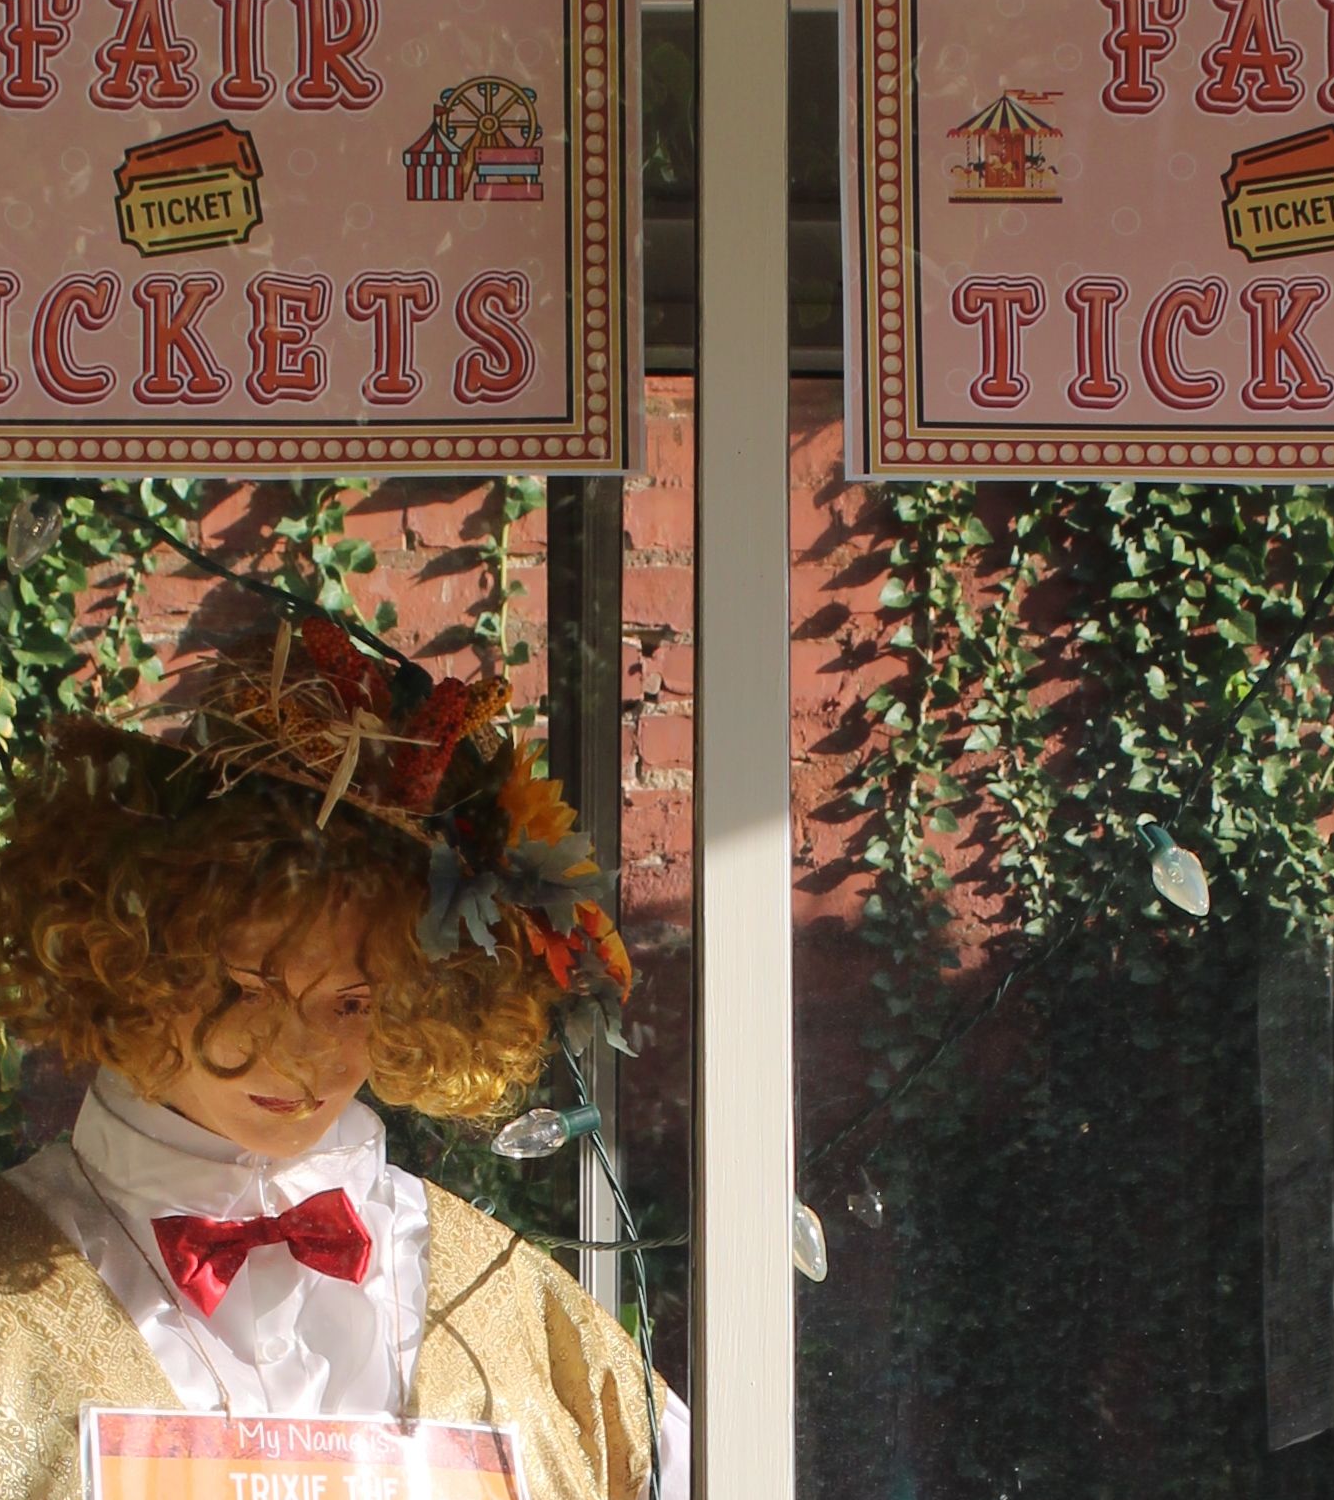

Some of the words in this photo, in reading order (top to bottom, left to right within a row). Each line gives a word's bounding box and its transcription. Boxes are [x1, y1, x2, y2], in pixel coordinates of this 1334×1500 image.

[140, 192, 234, 231] TICKET
[239, 1422, 281, 1458] My
[288, 1424, 357, 1452] Name
